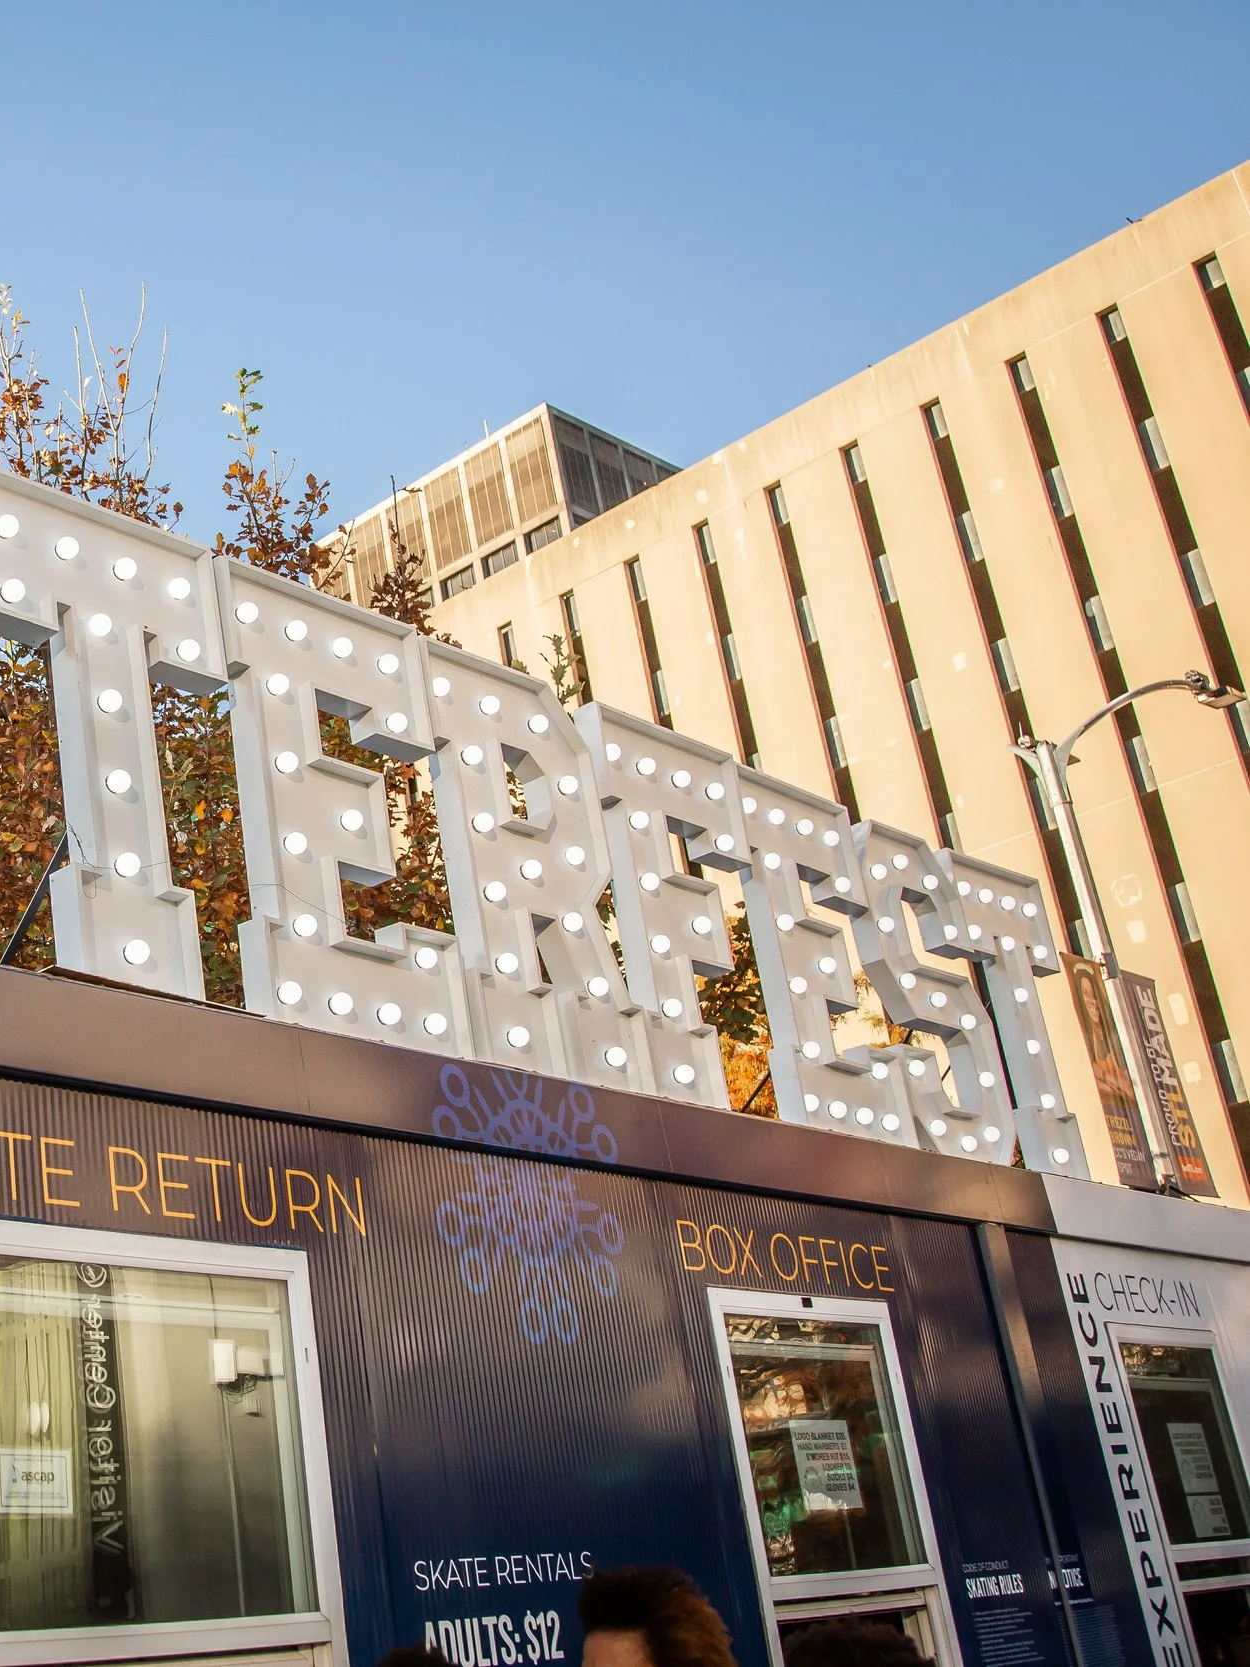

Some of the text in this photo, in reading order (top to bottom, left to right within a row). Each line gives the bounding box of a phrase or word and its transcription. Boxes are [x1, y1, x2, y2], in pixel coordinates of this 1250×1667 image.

[1150, 1064, 1165, 1083] TO
[1158, 1089, 1181, 1147] PROUD
[107, 1146, 367, 1237] RETURN
[676, 1219, 895, 1292] BOX OFFICE
[1093, 1272, 1201, 1318] CHECK-IN
[795, 1432, 811, 1440] LOGO
[811, 1432, 835, 1441] BLANKET
[797, 1442, 813, 1451] HAND
[813, 1442, 840, 1451] WARMERS
[830, 1453, 840, 1461] KIT
[1066, 1272, 1184, 1667] EXPERIENCE
[21, 1471, 55, 1484] ascap
[826, 1483, 847, 1491] GLOVES
[414, 1551, 595, 1591] SKATE RENTALS
[965, 1573, 1024, 1599] SKATING RULES
[425, 1610, 565, 1667] ADULTS: $12
